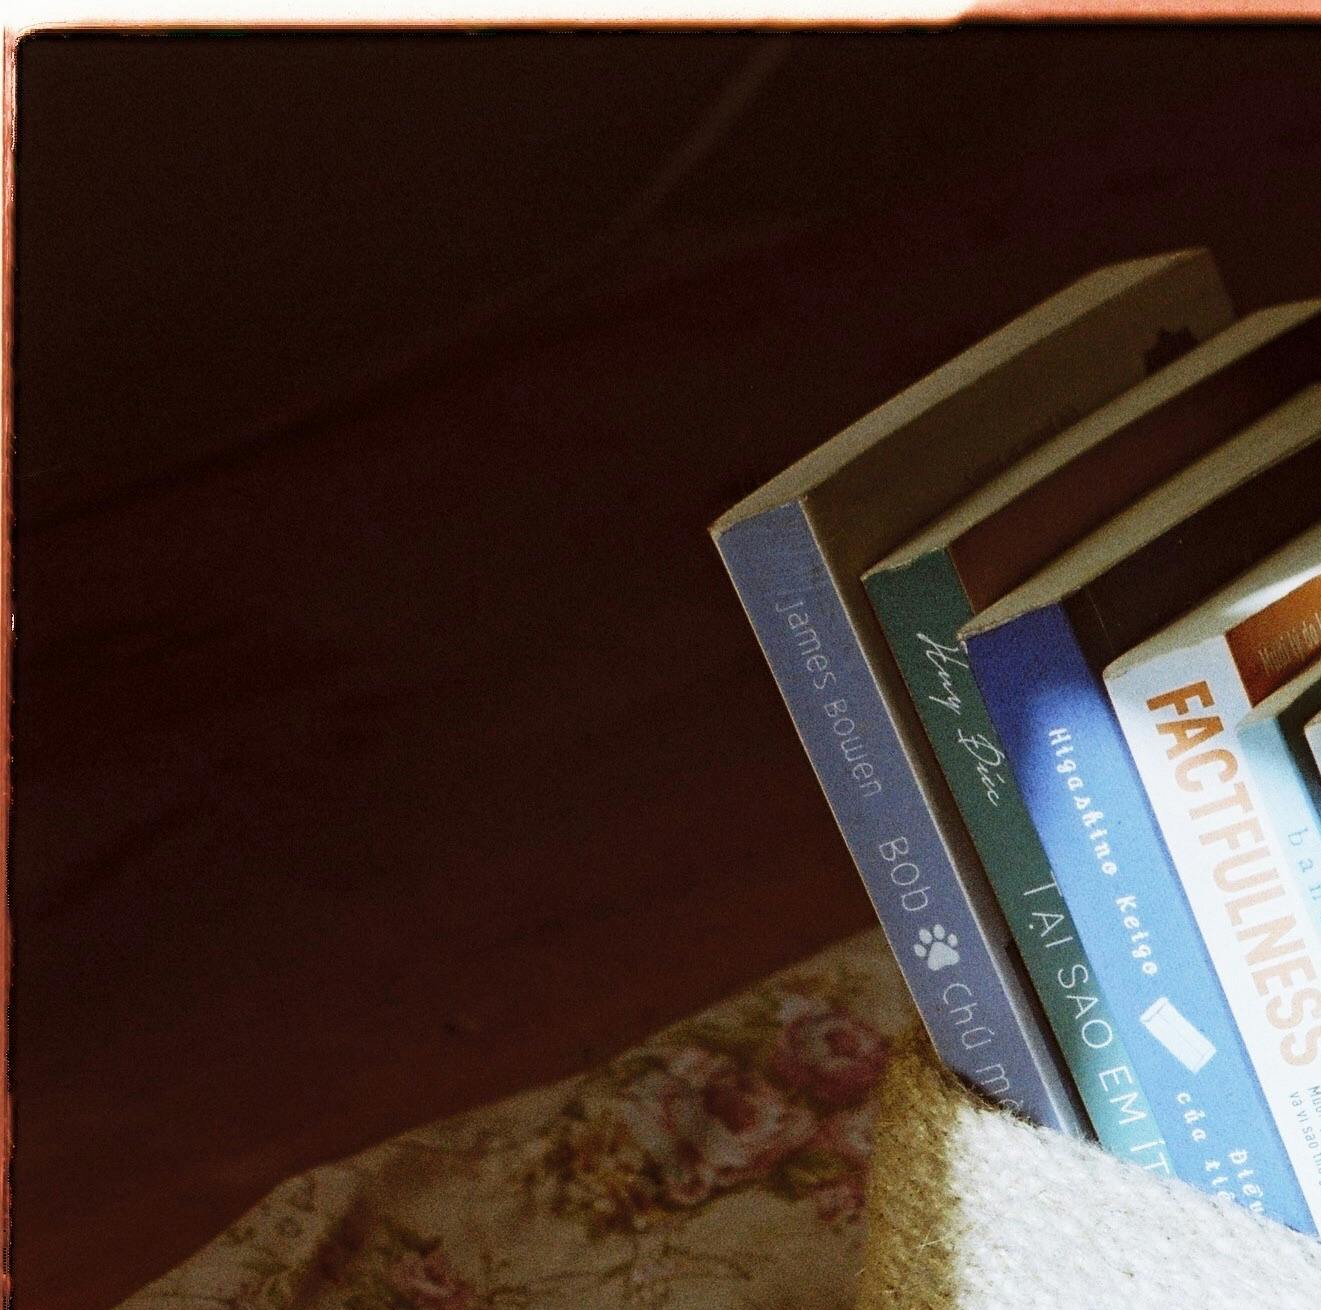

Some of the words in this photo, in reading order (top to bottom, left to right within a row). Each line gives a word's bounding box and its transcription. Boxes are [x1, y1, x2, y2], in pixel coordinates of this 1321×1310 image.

[775, 600, 837, 690] James
[823, 699, 882, 798] Bowen
[879, 836, 932, 912] Bob
[943, 983, 996, 1050] Chú
[1049, 727, 1118, 876] Higashino
[1115, 894, 1158, 976] Keigo
[1024, 870, 1073, 948] TẠI
[1058, 963, 1113, 1049] SAO
[1100, 1065, 1147, 1126] EM
